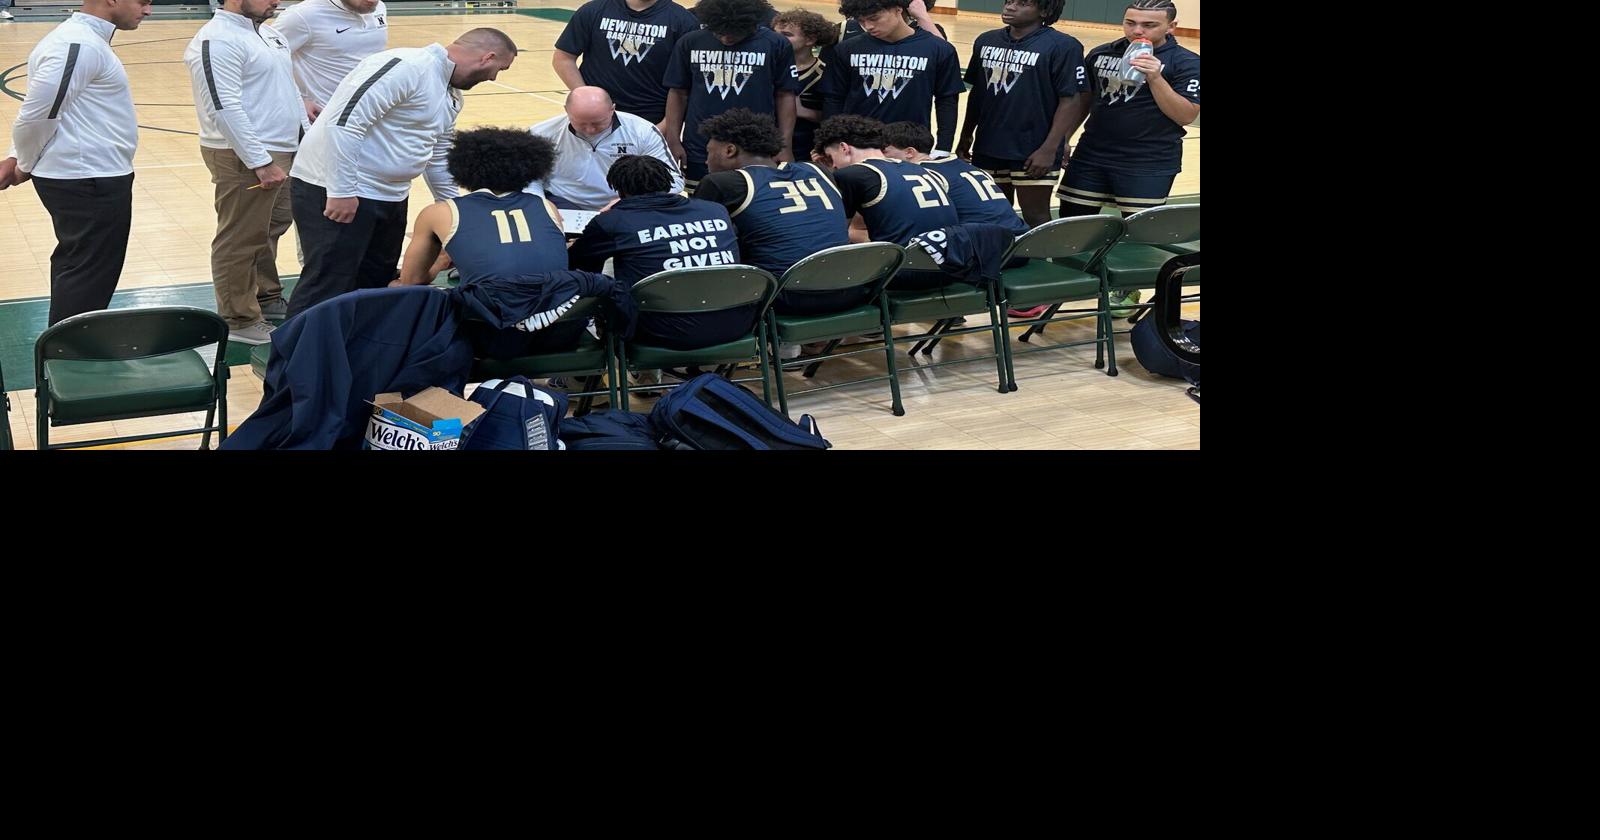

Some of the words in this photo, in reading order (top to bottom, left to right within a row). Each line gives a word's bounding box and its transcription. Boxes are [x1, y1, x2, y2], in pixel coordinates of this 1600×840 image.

[690, 50, 766, 66] NEWINGTON
[850, 54, 928, 71] NEWINGTON
[1186, 79, 1200, 92] 2
[617, 146, 628, 154] N
[769, 178, 834, 214] 34
[902, 174, 950, 208] 21
[960, 170, 1007, 201] 12
[491, 209, 532, 243] 11
[637, 219, 729, 244] EARNED
[669, 235, 717, 254] NOT
[662, 250, 735, 270] GIVEN
[370, 420, 425, 450] Welch's
